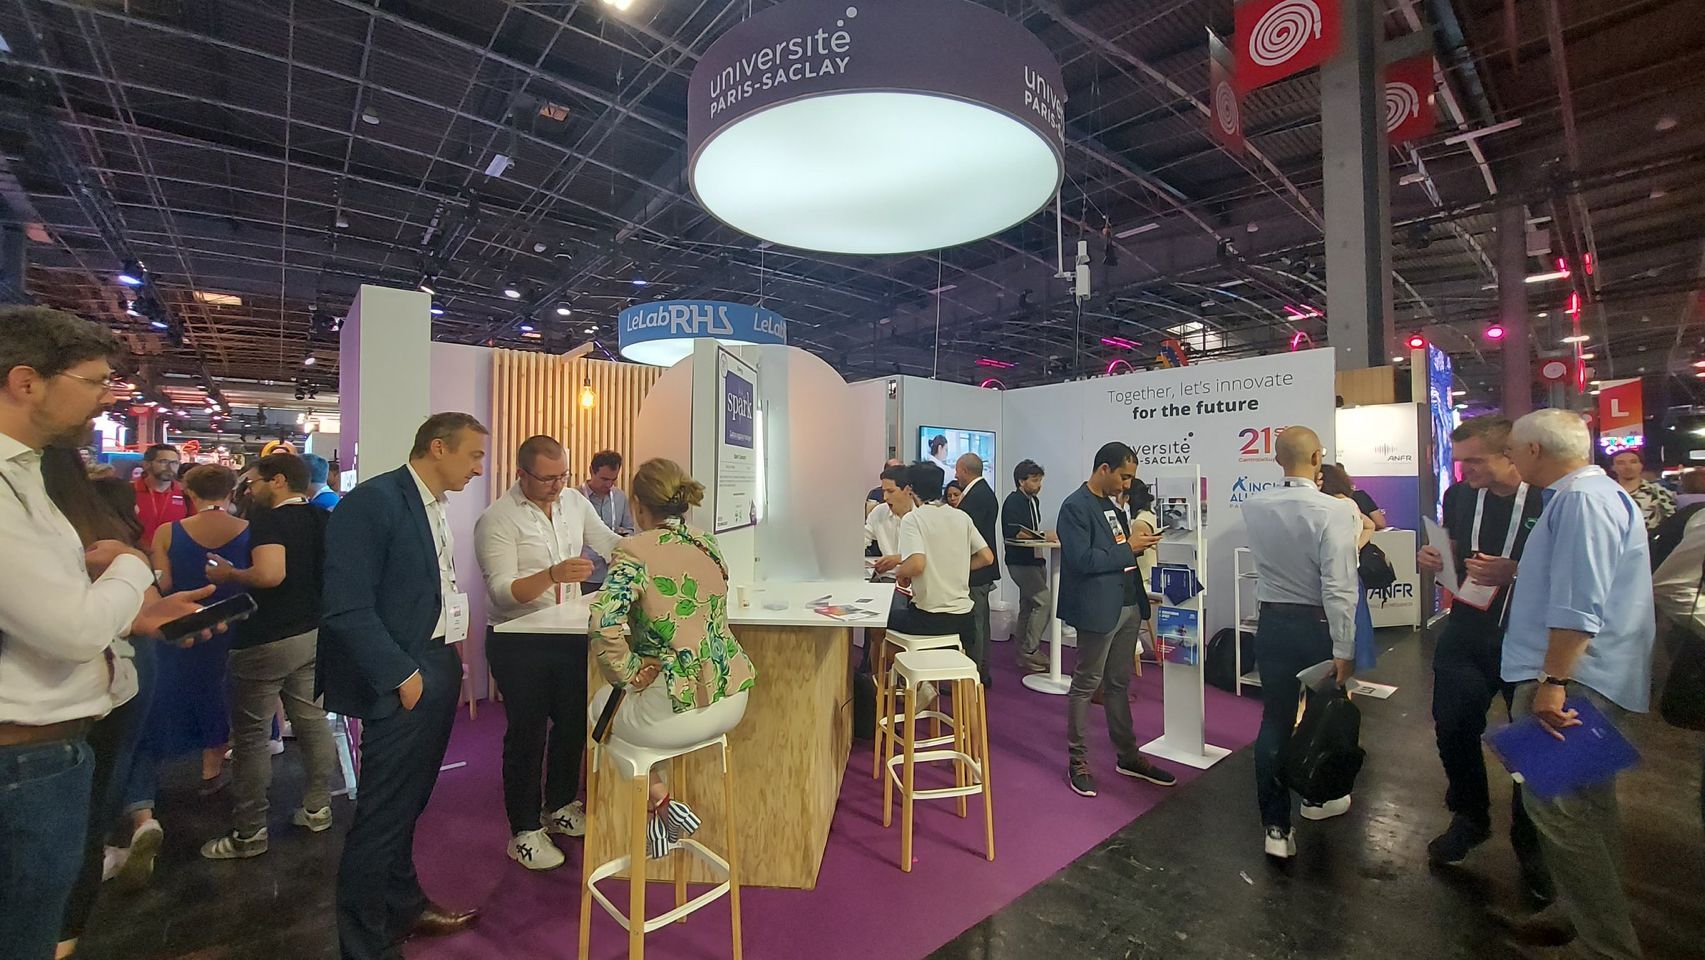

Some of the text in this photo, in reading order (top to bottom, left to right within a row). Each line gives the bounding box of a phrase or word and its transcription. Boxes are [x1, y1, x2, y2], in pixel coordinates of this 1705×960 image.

[710, 56, 850, 118] PARIS-SACLAY
[1107, 371, 1293, 406] Together, let's innovate
[727, 391, 753, 421] spark
[1133, 398, 1259, 420] for the future
[1610, 398, 1630, 418] L
[1139, 455, 1190, 465] -SACLAY
[1387, 454, 1412, 462] ANFR
